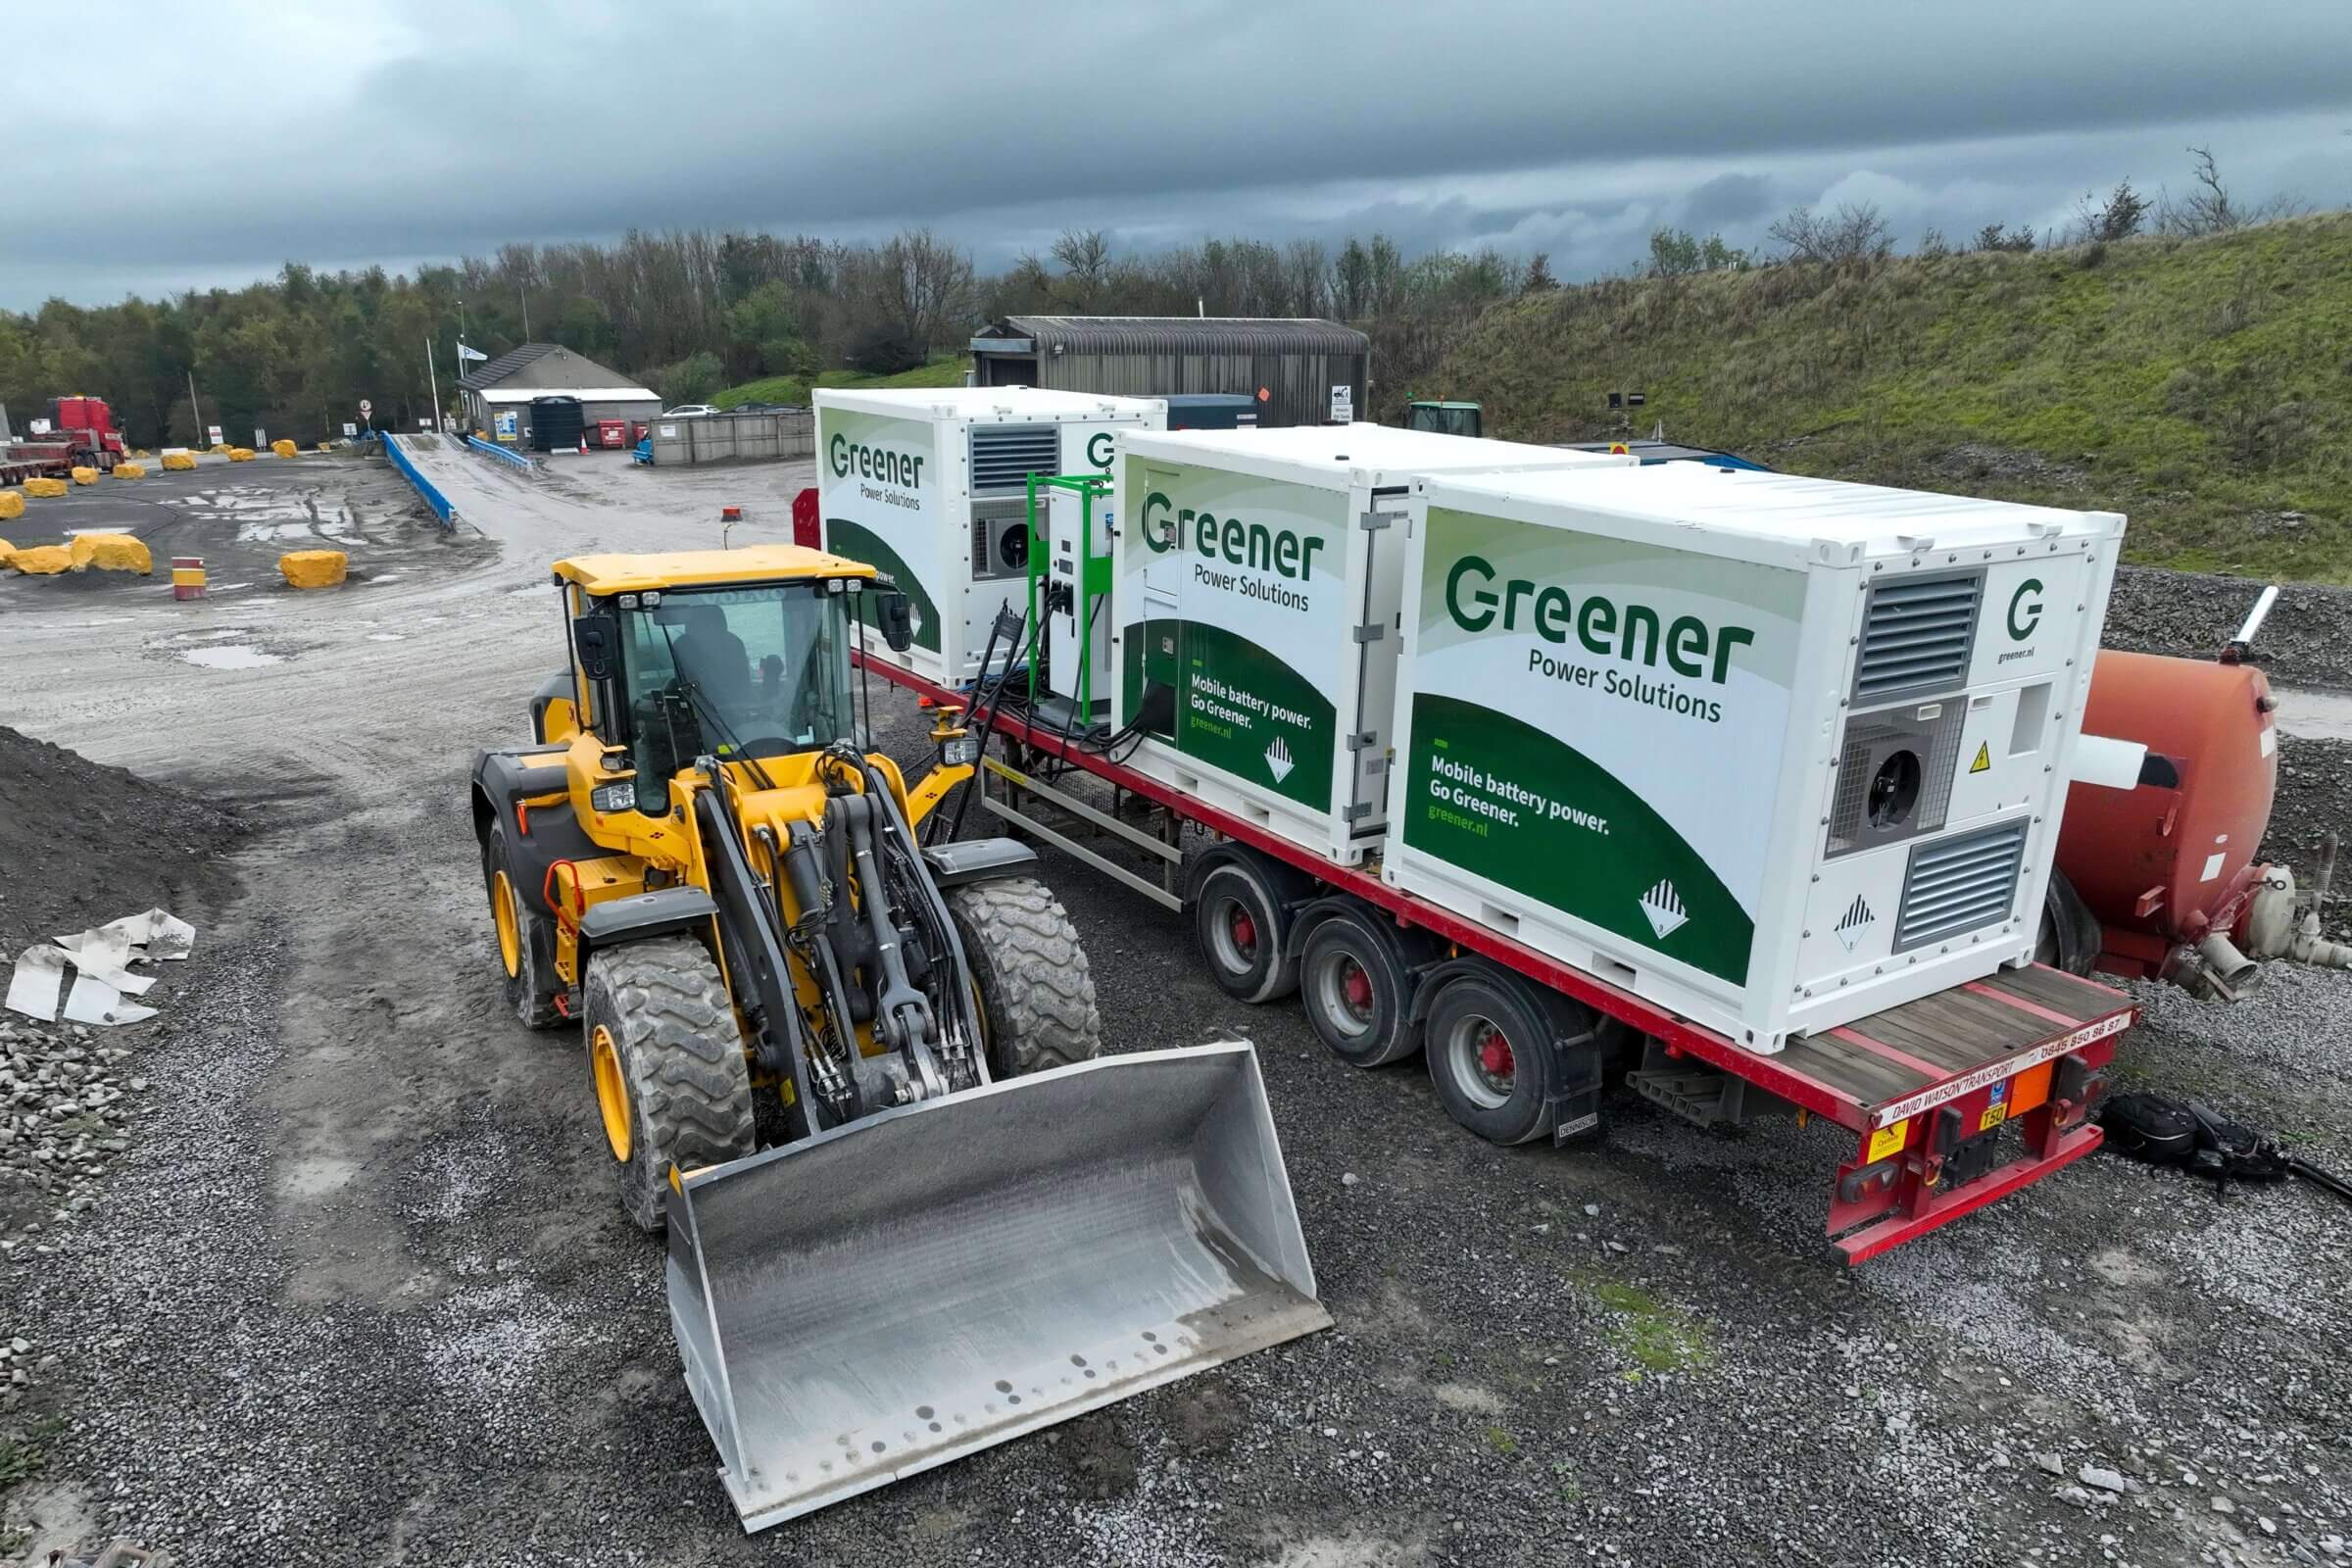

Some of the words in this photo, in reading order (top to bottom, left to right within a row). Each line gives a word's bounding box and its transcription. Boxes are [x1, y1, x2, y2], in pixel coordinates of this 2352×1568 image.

[830, 433, 924, 489] Greener
[860, 483, 883, 501] Power
[884, 488, 920, 511] Solutions
[1142, 492, 1324, 581] Greener
[701, 588, 787, 605] VOLVO
[1195, 564, 1237, 592] Power
[1240, 575, 1309, 612] Solutions
[2007, 578, 2043, 641] G
[1446, 555, 1755, 685] Greener
[1997, 646, 2034, 664] greener.nl
[1191, 694, 1205, 710] Go
[1206, 700, 1252, 729] Greener.
[1192, 673, 1227, 699] Mobile
[1228, 685, 1270, 717] battery
[1271, 705, 1312, 730] power.
[1529, 649, 1598, 688] Power
[1603, 668, 1722, 723] Solutions
[1191, 715, 1232, 739] greener.nl
[1430, 779, 1450, 800] Go
[1452, 788, 1519, 827] Greener.
[1432, 755, 1483, 789] Mobile
[1486, 773, 1547, 814] battery
[1549, 801, 1610, 835] power.
[1428, 805, 1489, 838] greener.nl
[1892, 1098, 1922, 1120] DAVID
[1924, 1083, 1962, 1106] WATSON
[1964, 1061, 2015, 1090] TRANSPORT
[2040, 1040, 2068, 1059] 0845
[2070, 1031, 2089, 1048] 850
[2091, 1024, 2105, 1037] 86
[2107, 1018, 2121, 1032] 87
